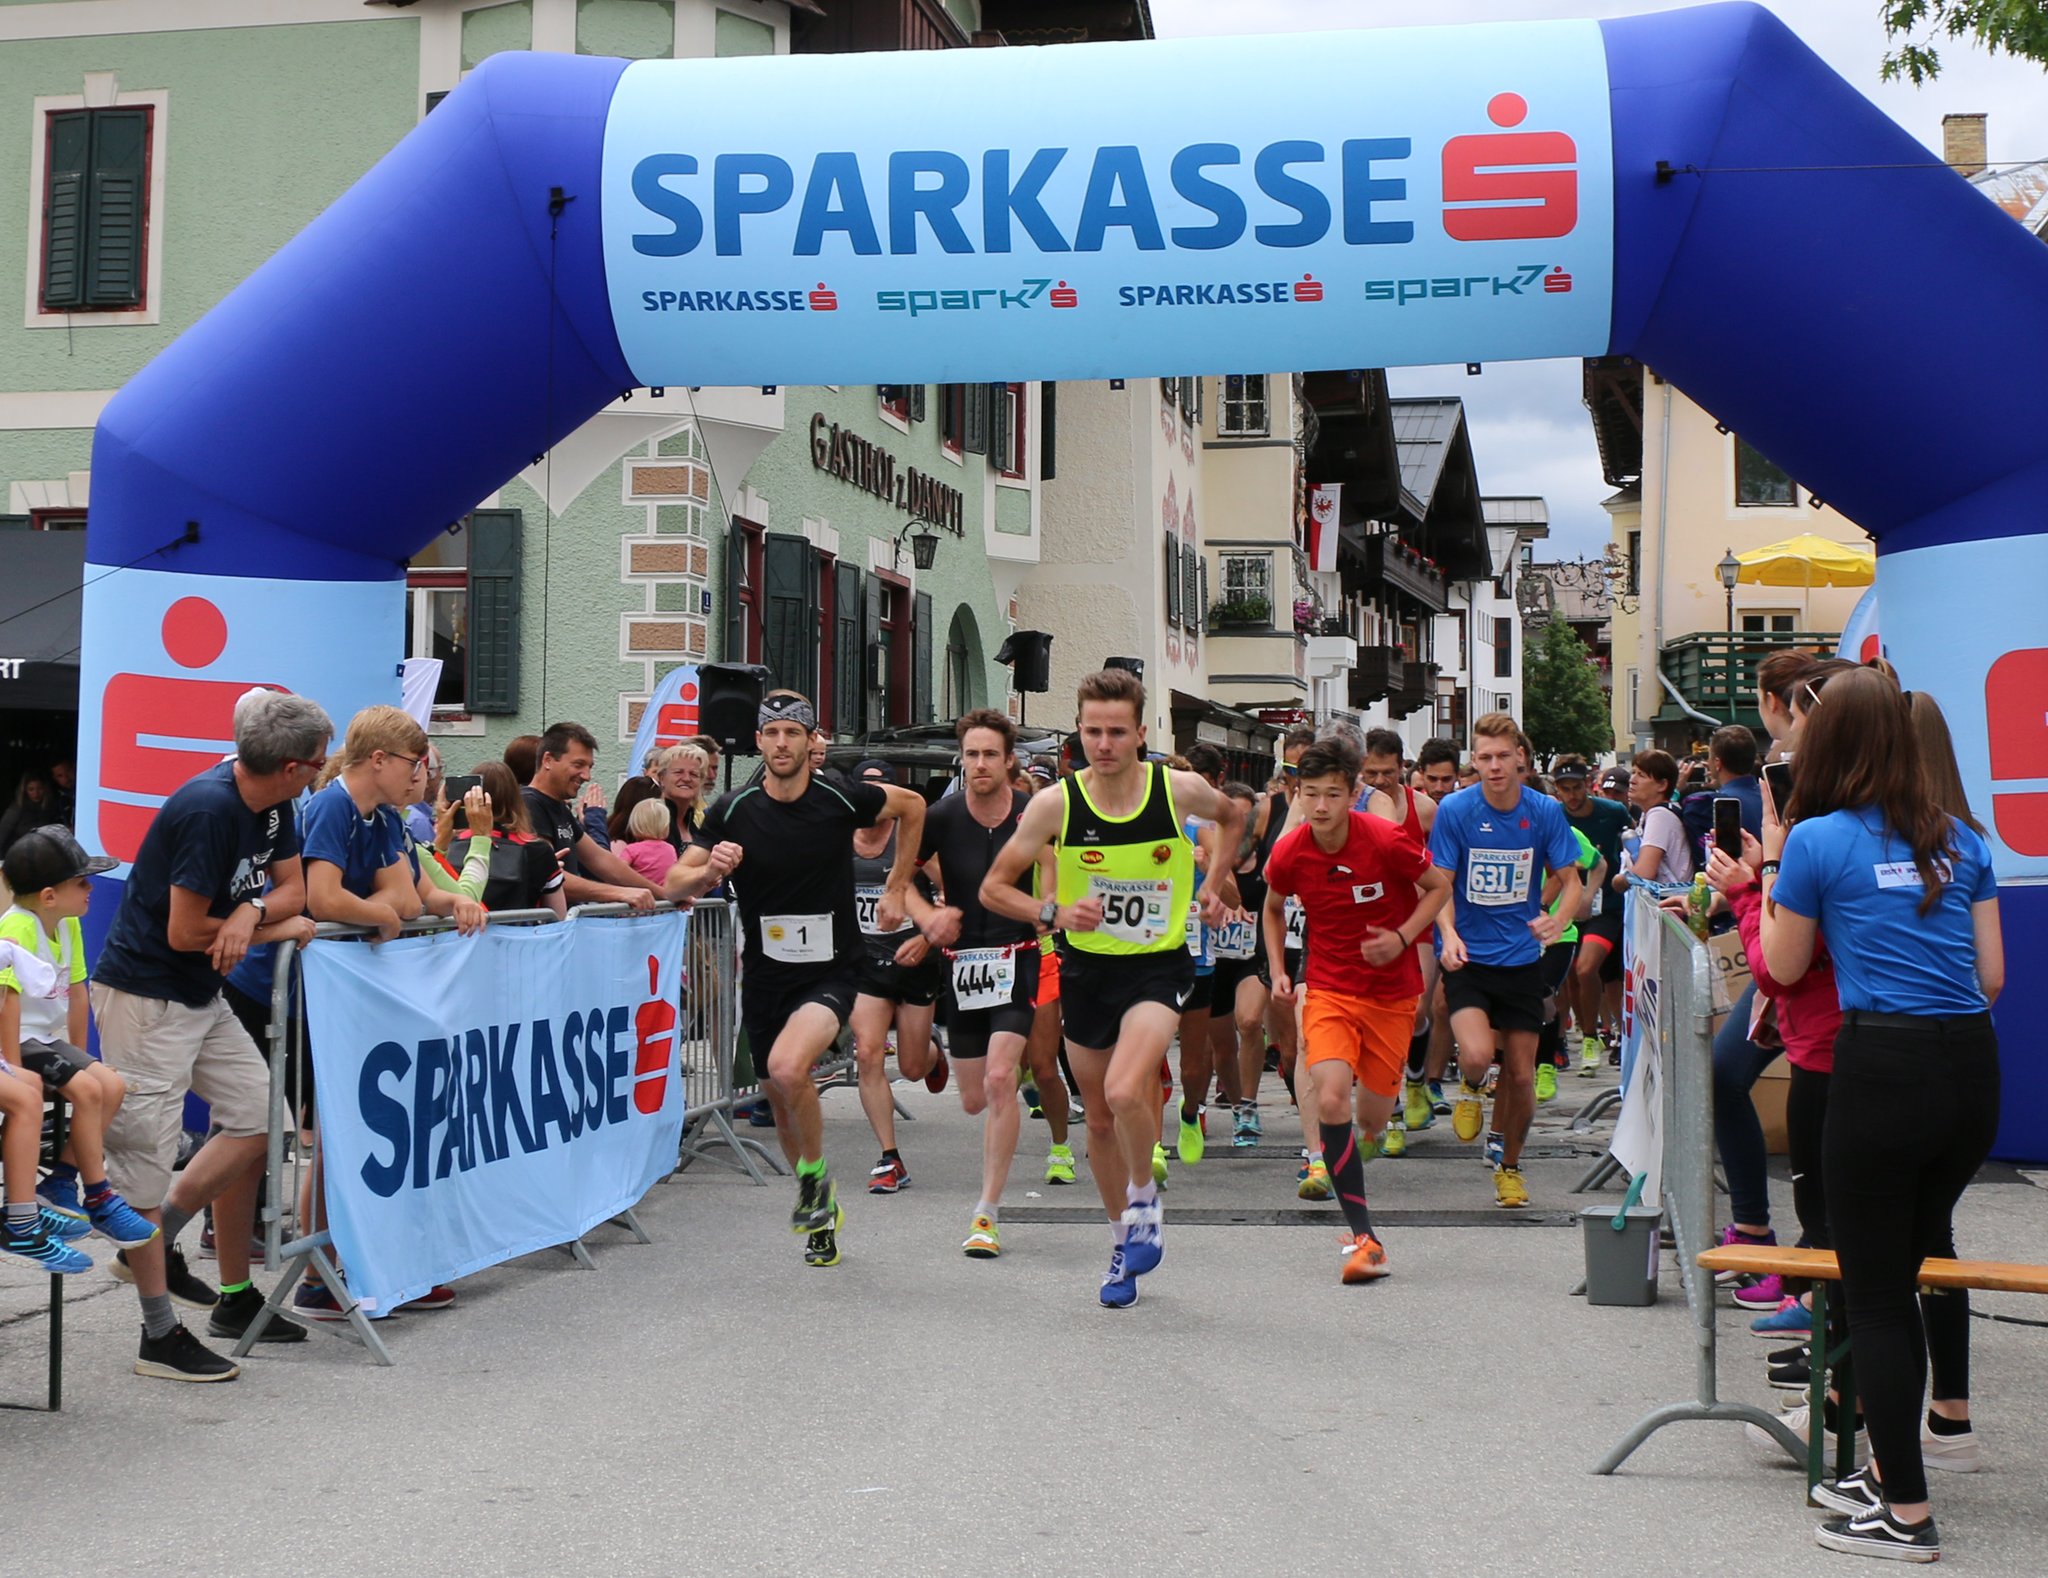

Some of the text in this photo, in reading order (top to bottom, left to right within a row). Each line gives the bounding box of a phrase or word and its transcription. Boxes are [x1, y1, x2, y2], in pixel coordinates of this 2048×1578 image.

[632, 137, 1414, 256] SPARKASSE
[642, 290, 805, 312] SPARKASSE
[1119, 282, 1289, 306] SPARKASSE
[810, 412, 896, 502] GASTHOF
[1093, 880, 1155, 892] SPARKASSE
[1471, 864, 1508, 892] 631
[1098, 893, 1145, 928] 50
[797, 926, 807, 945] 1
[957, 963, 995, 996] 444
[358, 1006, 630, 1198] SPARKASSE
